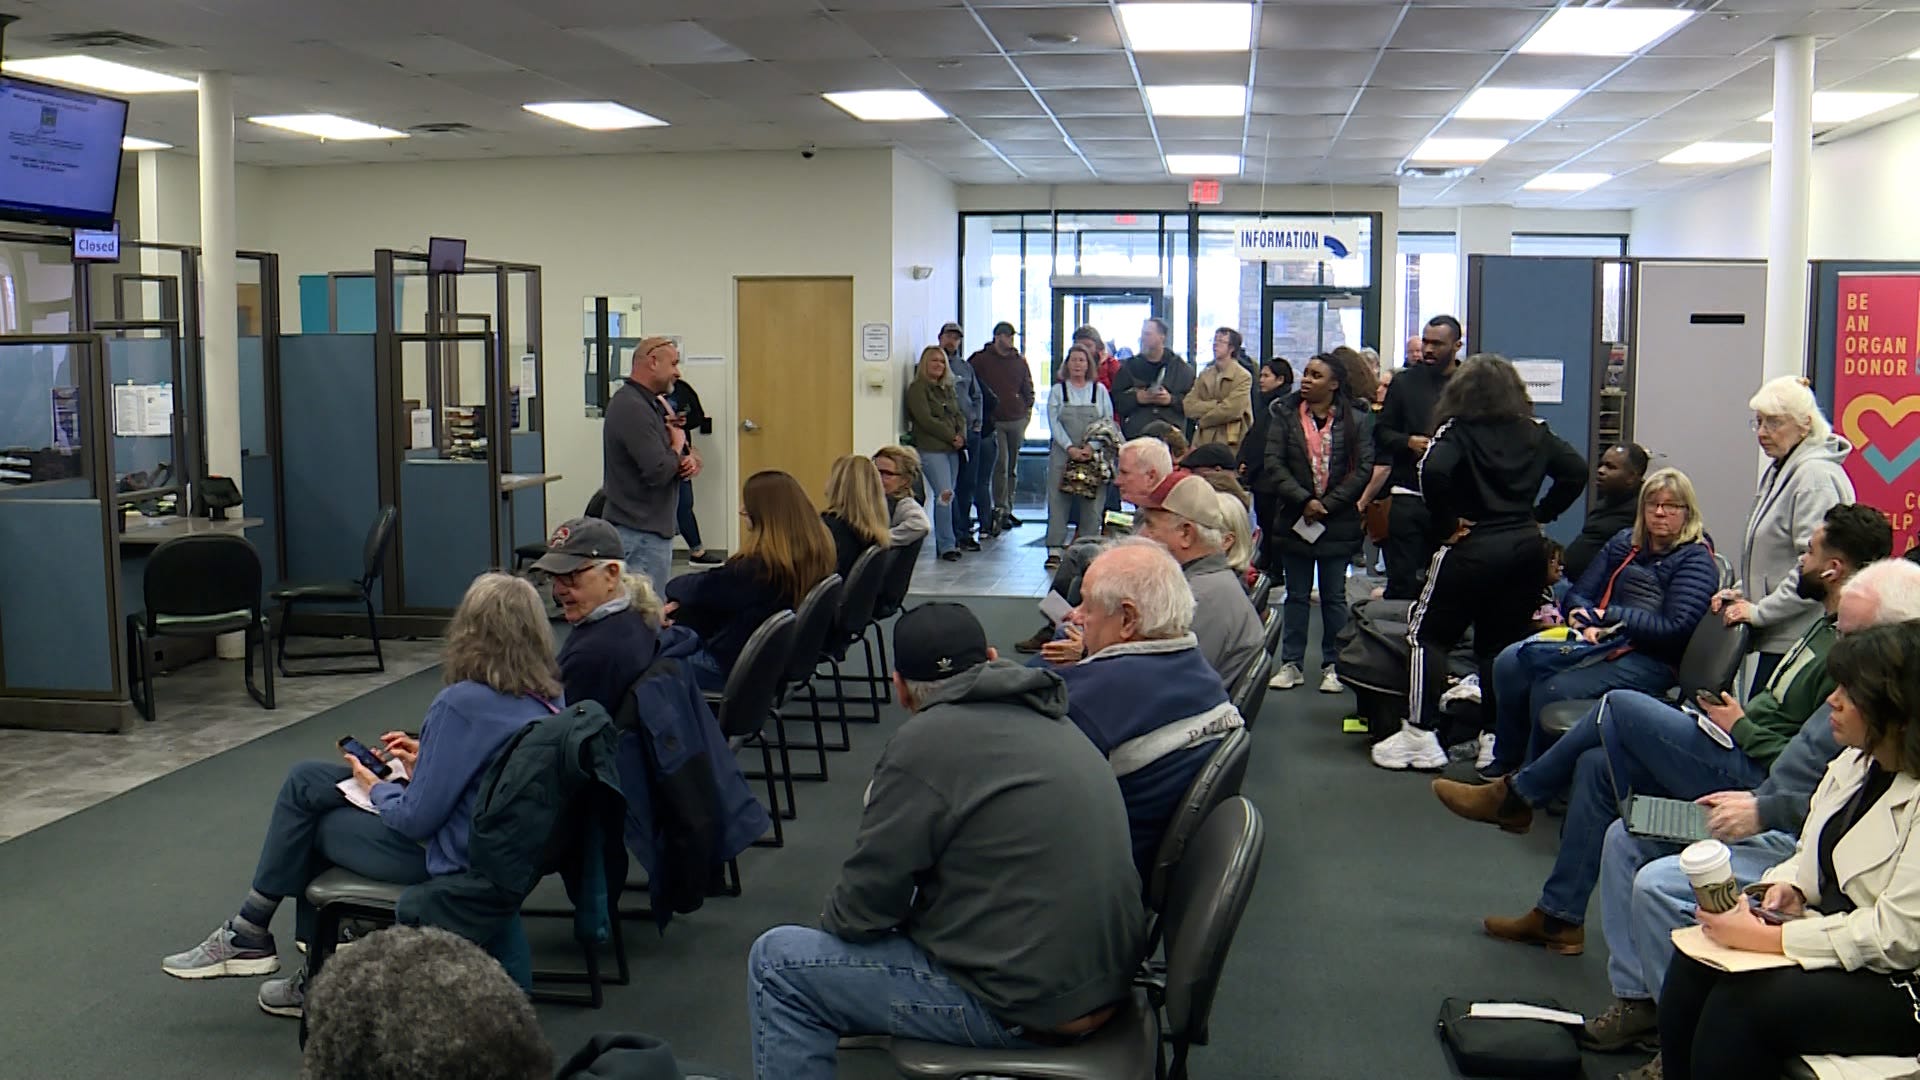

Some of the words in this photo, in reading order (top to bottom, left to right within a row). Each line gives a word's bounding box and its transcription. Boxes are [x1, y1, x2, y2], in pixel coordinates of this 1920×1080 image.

[78, 239, 115, 252] Closed
[1241, 231, 1319, 247] INFORMATION
[1847, 293, 1868, 310] BE
[1845, 315, 1869, 332] AN
[1845, 337, 1907, 354] ORGAN
[1844, 358, 1908, 376] DONOR
[1905, 492, 1920, 510] C
[1883, 513, 1913, 530] LP
